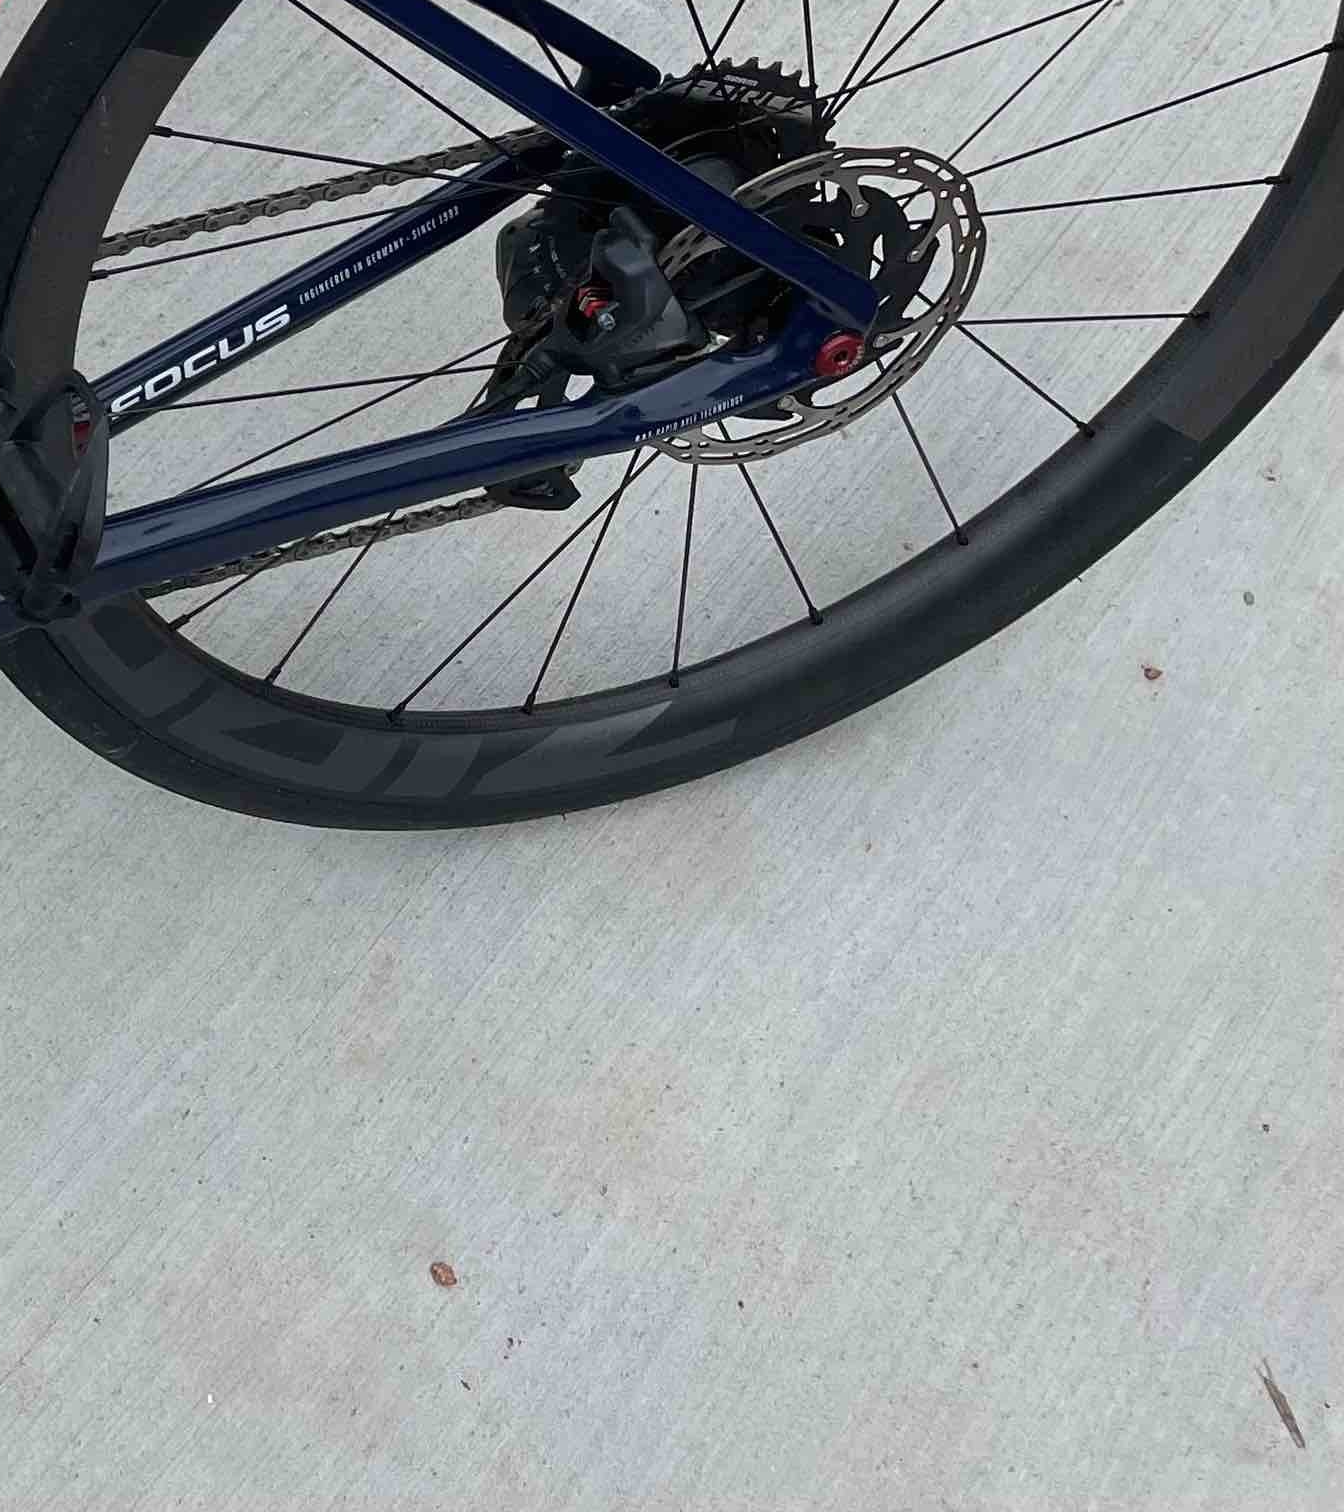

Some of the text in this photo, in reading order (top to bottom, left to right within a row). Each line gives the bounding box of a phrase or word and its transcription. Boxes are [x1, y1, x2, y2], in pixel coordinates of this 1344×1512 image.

[299, 267, 351, 305] ENGINEERED
[353, 259, 364, 275] IN
[366, 236, 404, 268] GERMANY
[411, 220, 437, 241] SINCE
